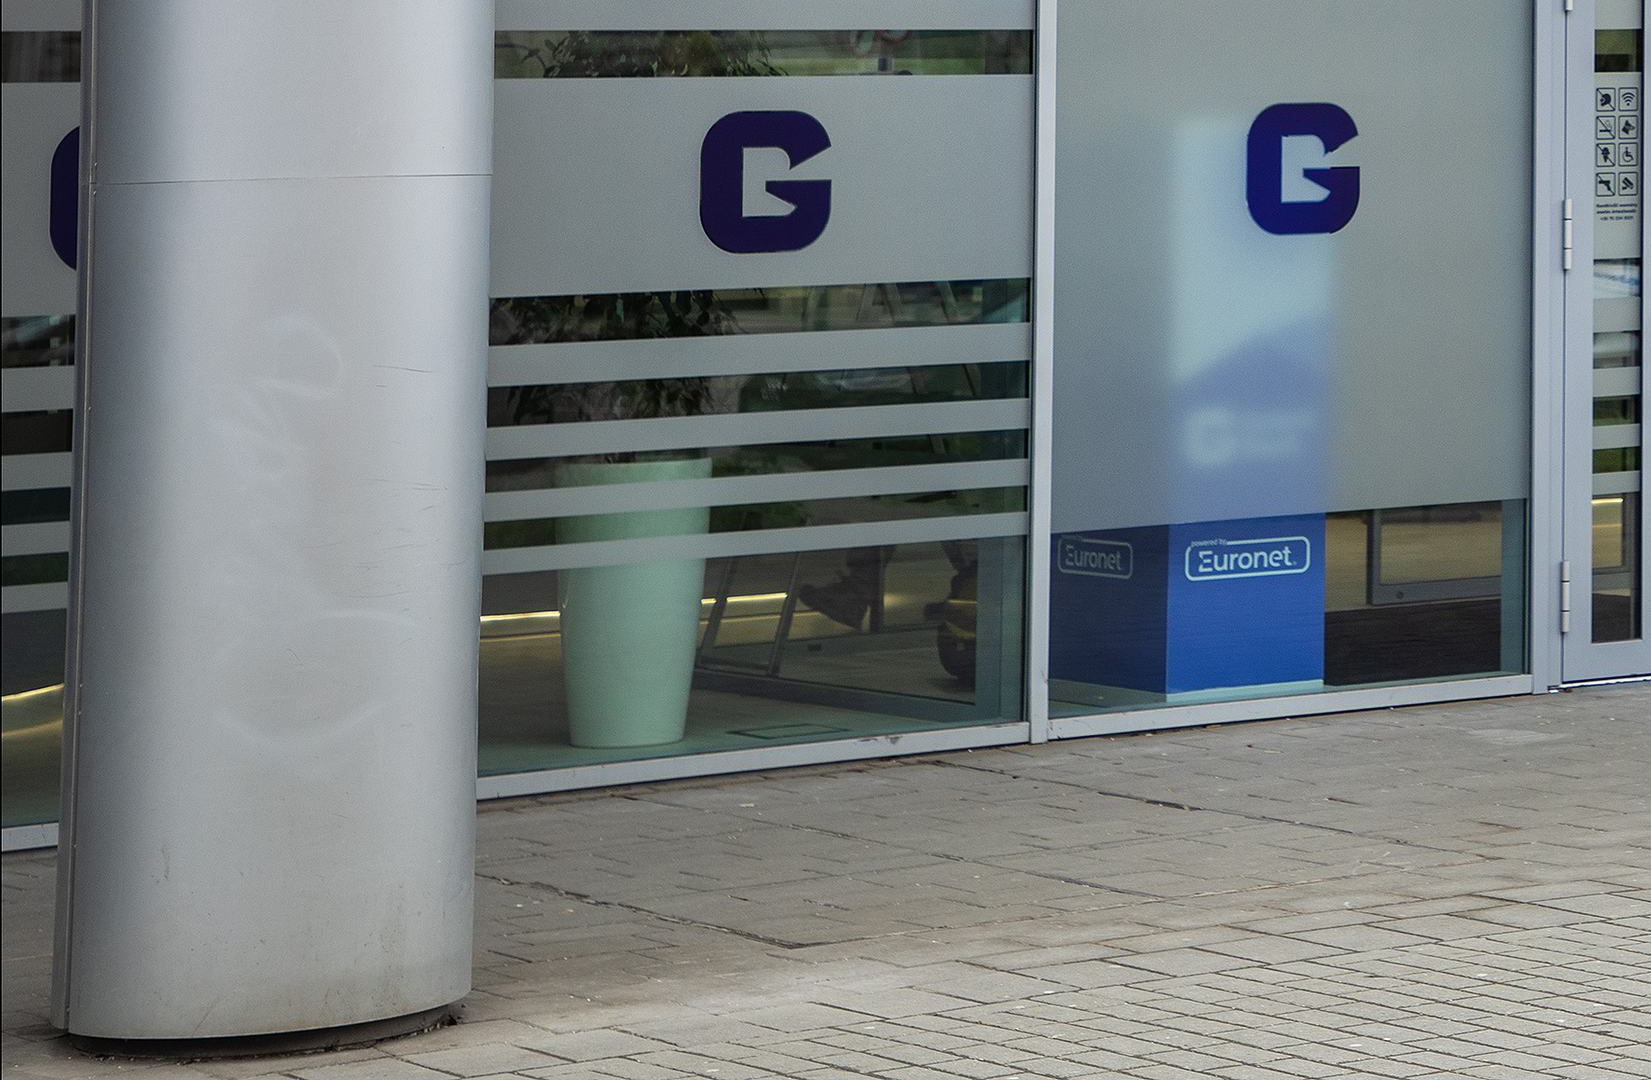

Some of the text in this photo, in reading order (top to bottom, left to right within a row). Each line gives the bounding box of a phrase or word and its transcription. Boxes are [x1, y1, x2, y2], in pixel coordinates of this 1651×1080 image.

[699, 110, 831, 254] G
[1246, 102, 1360, 235] G
[1198, 546, 1293, 572] Euronet
